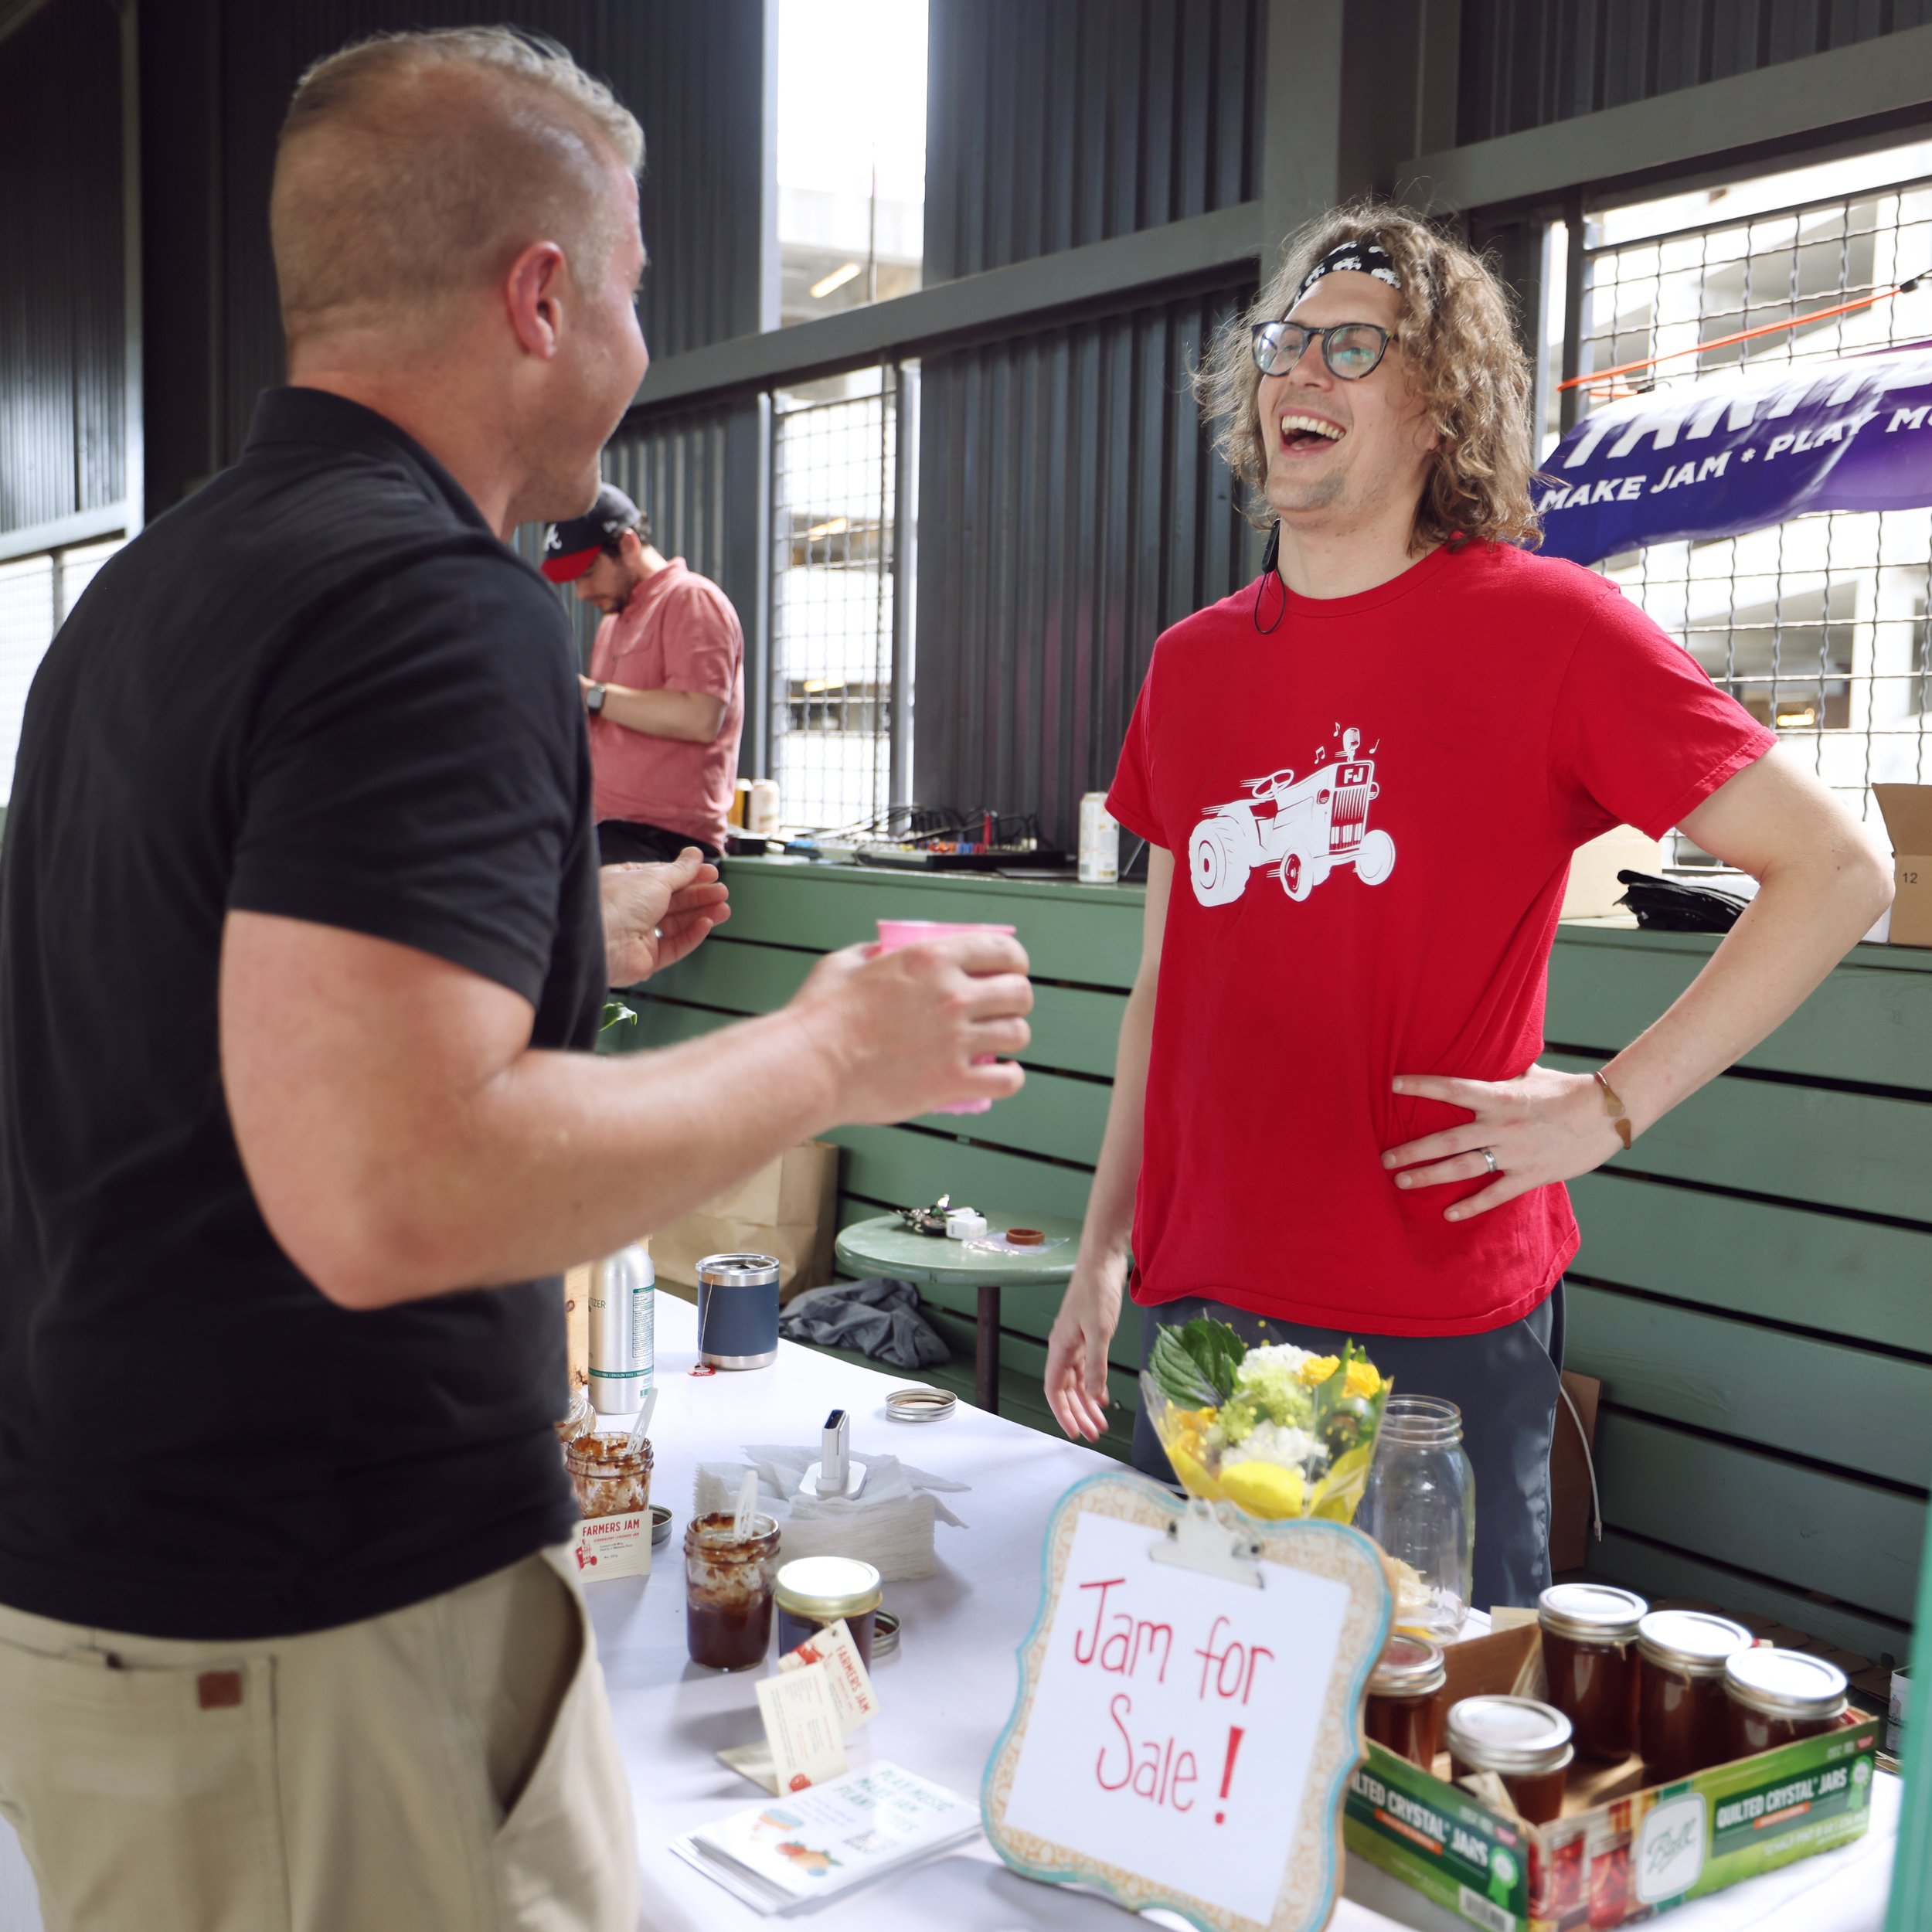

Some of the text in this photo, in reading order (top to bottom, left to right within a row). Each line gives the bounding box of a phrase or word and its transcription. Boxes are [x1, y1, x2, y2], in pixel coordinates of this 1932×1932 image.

[1537, 474, 1647, 513] MAKE
[1650, 451, 1733, 494] JAM
[1764, 410, 1880, 462] PLAY
[1344, 767, 1364, 784] FJ
[1903, 872, 1917, 884] 12
[583, 1519, 640, 1536] FARMERS JAM
[1074, 1577, 1275, 1705] Jam for
[837, 1644, 862, 1692] FARMERS
[857, 1693, 871, 1714] JAM
[1387, 1789, 1447, 1844] CRYSTAL
[1450, 1827, 1488, 1867] JARS
[1716, 1794, 1765, 1829] QUILTED
[1765, 1780, 1815, 1811] CRYSTAL
[1818, 1767, 1848, 1795] JARS
